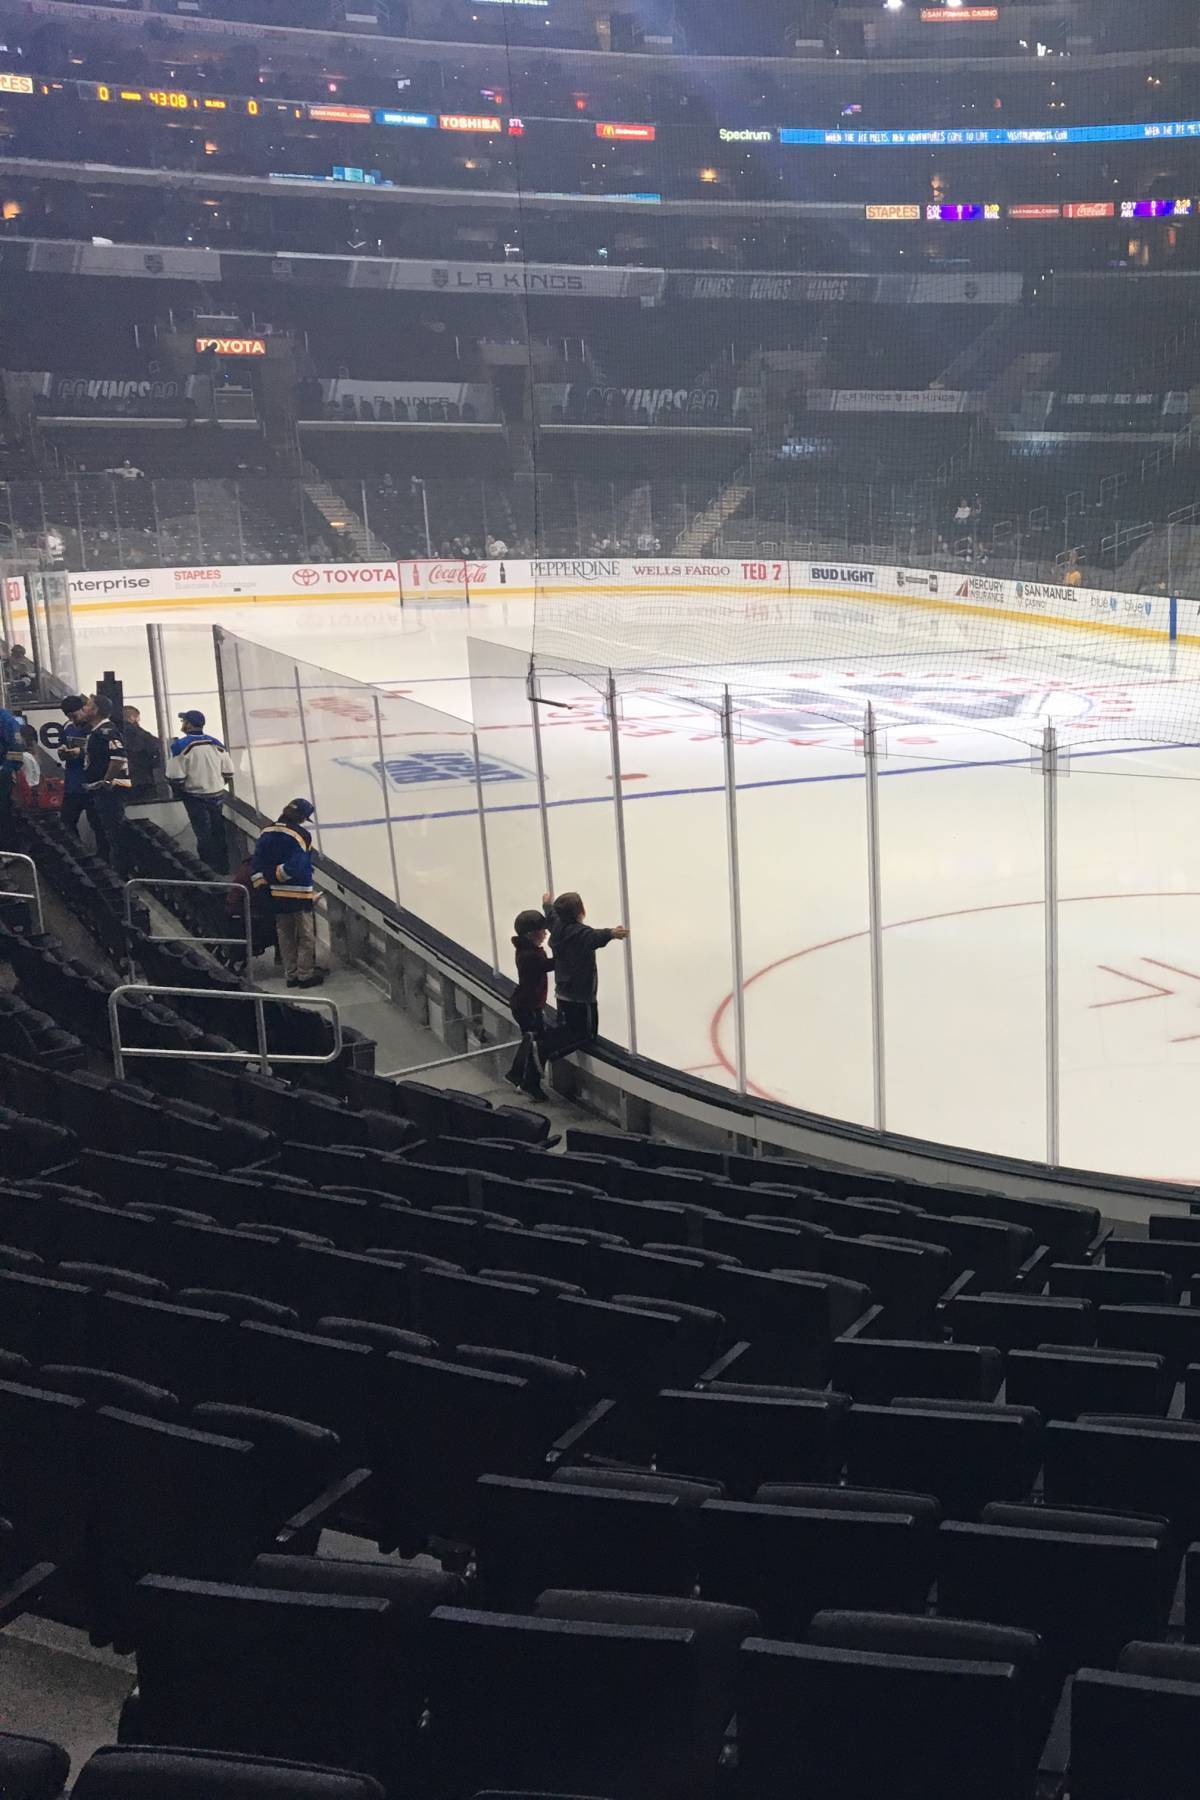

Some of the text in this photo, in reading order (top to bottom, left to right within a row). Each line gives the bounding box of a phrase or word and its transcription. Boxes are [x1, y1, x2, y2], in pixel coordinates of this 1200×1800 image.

[149, 92, 188, 108] 43:08
[442, 116, 500, 130] TOSHIBA
[719, 128, 771, 142] Spectrum
[868, 206, 918, 218] STAPLES
[457, 271, 583, 290] LA KINGS
[196, 338, 265, 354] TOYOTA
[174, 570, 222, 581] STAPLES
[323, 569, 396, 583] TOYOTA
[428, 563, 488, 584] Coca-Cola
[528, 560, 621, 580] PEPPERDINE
[632, 565, 730, 576] WELLS FARGO
[741, 563, 782, 580] TED 7
[811, 567, 874, 583] BUD LIGHT
[69, 577, 150, 593] nterprise
[969, 577, 1004, 590] MERCURY
[969, 590, 1005, 604] INSURANCE
[1024, 584, 1078, 602] SAN MANUEL
